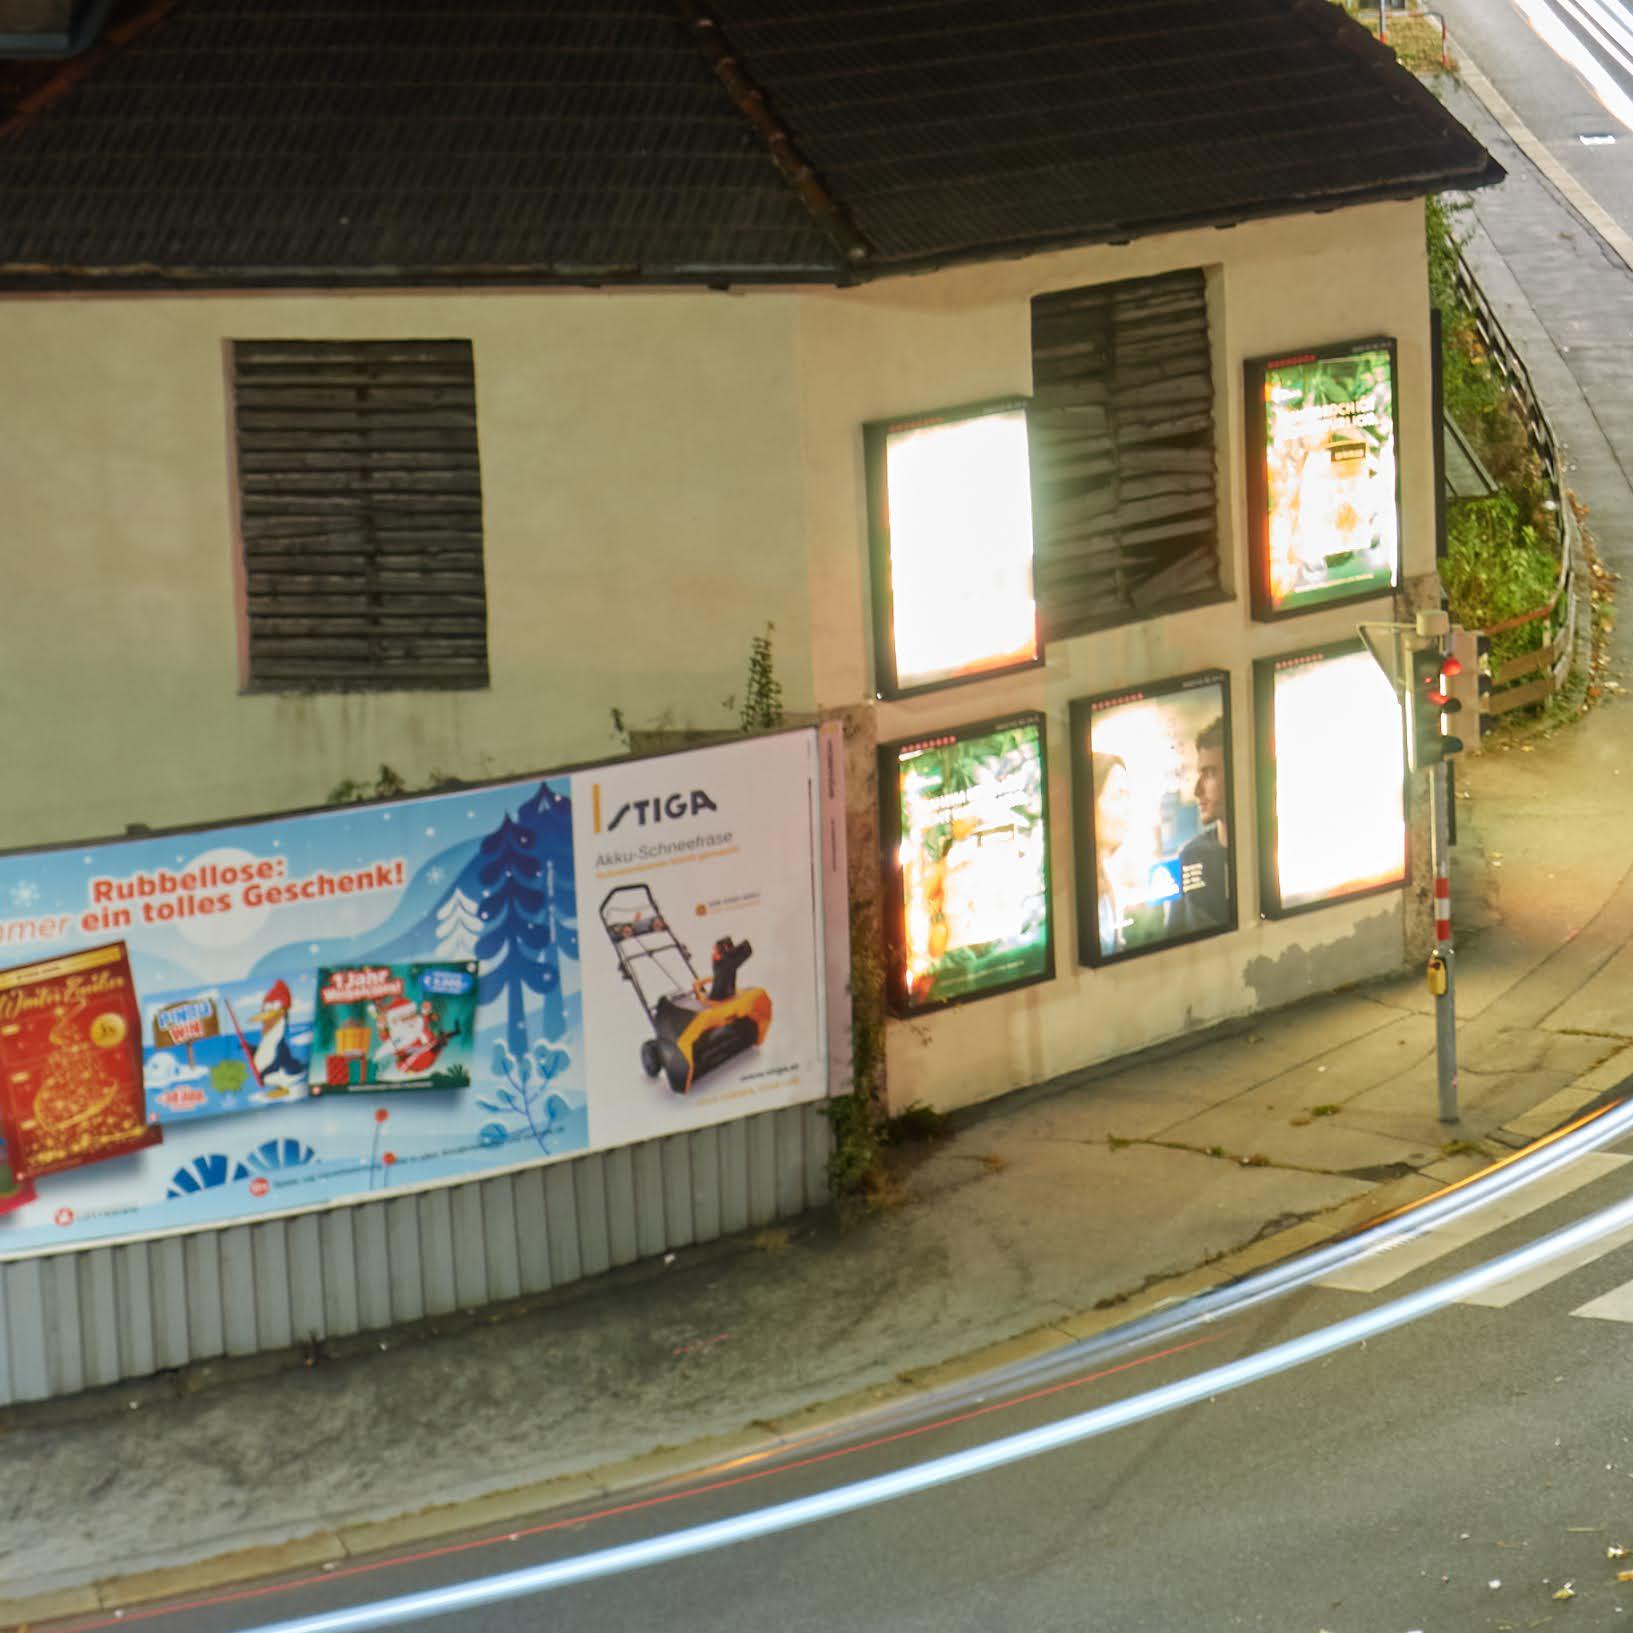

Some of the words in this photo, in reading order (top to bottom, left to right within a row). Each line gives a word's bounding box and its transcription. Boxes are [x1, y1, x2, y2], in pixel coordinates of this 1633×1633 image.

[607, 789, 717, 831] STIGA
[0, 914, 69, 945] mer
[81, 906, 131, 932] ein
[143, 887, 232, 922] tolles
[242, 861, 404, 908] Geschenk!
[93, 858, 286, 904] Rubbellose:
